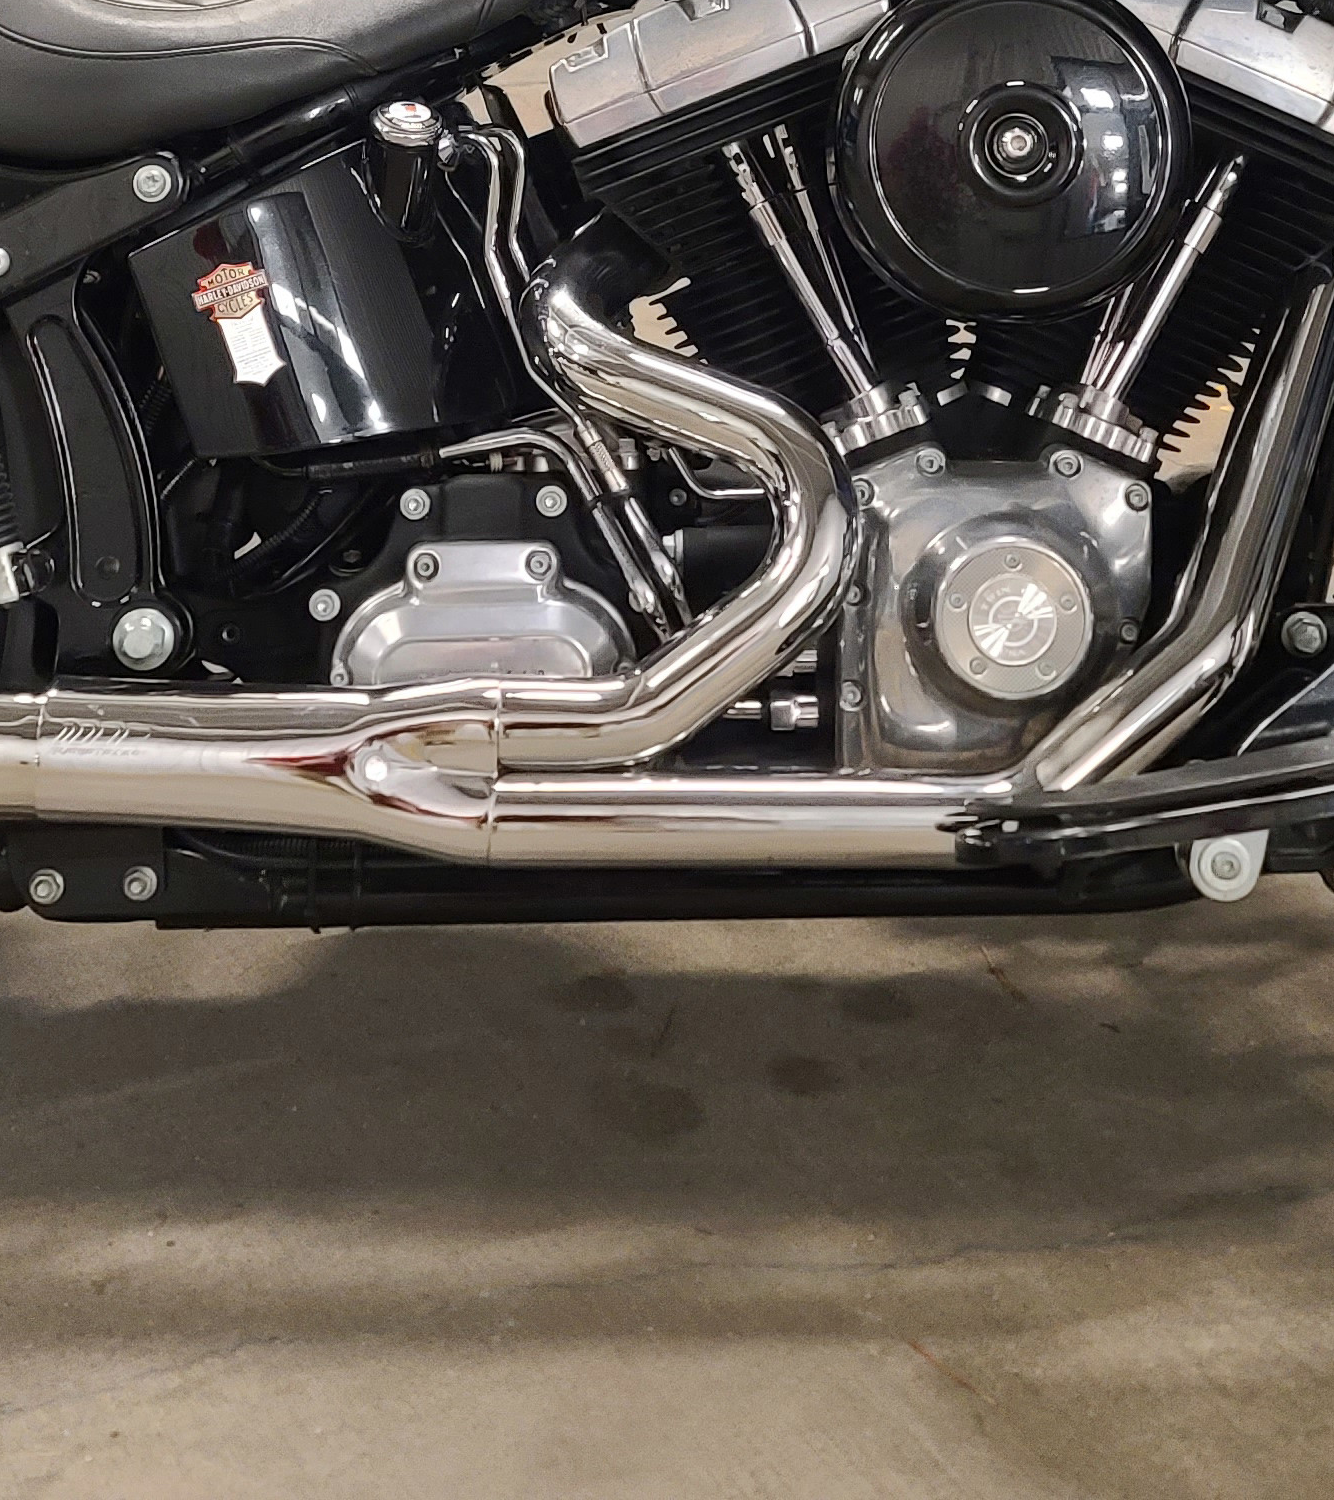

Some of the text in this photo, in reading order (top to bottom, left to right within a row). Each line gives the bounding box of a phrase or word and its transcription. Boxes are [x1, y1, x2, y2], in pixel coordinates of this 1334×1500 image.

[207, 267, 245, 287] MOTOR
[197, 274, 265, 306] HARLEY-DAVIDSON
[218, 293, 254, 313] CYCLES
